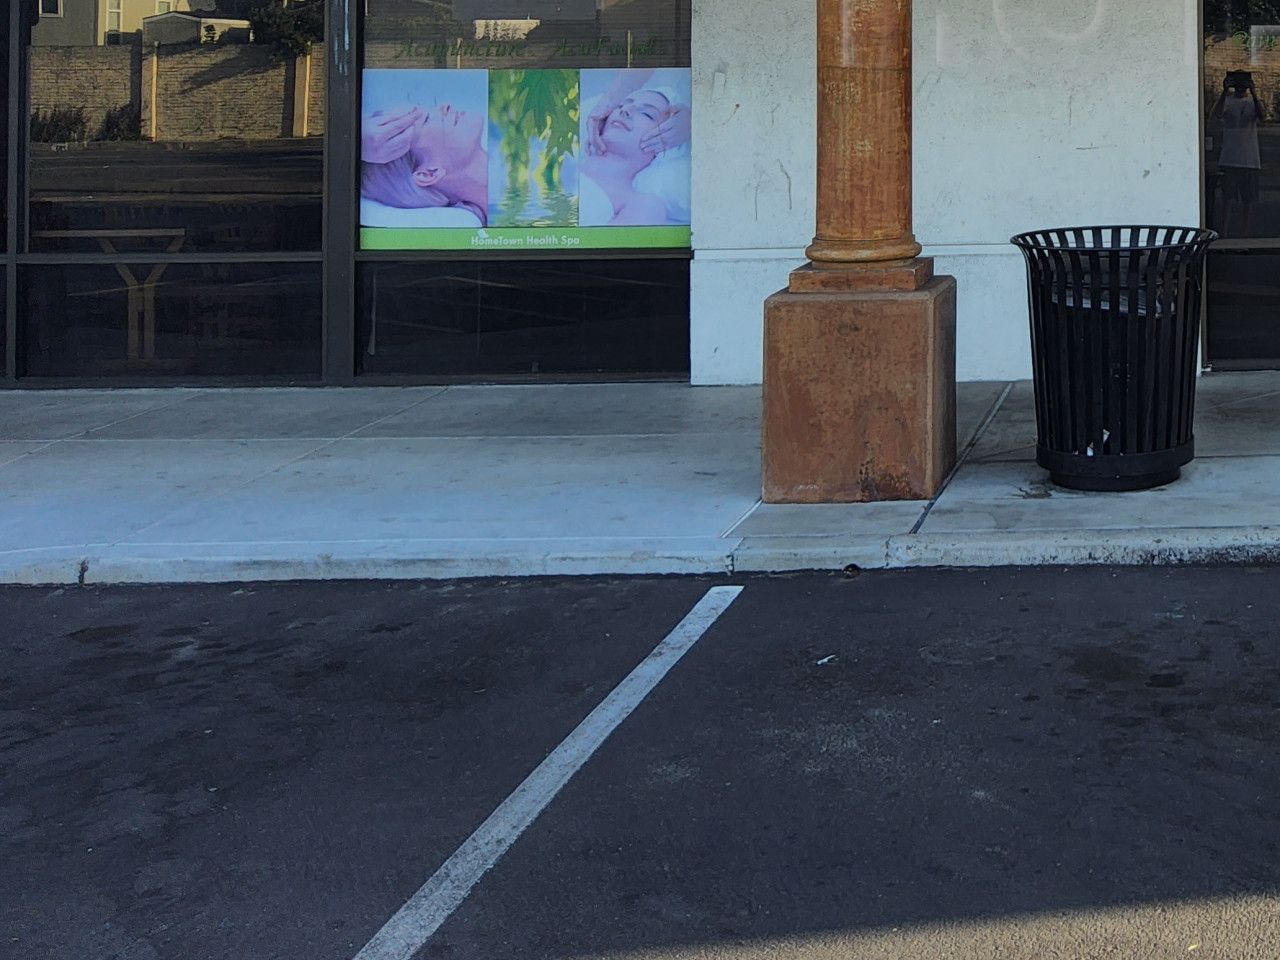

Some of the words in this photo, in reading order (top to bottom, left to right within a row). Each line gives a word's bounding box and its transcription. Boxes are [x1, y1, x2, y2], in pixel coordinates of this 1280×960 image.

[471, 235, 523, 246] HomeTown
[526, 235, 558, 245] Health
[561, 234, 580, 247] Spa
